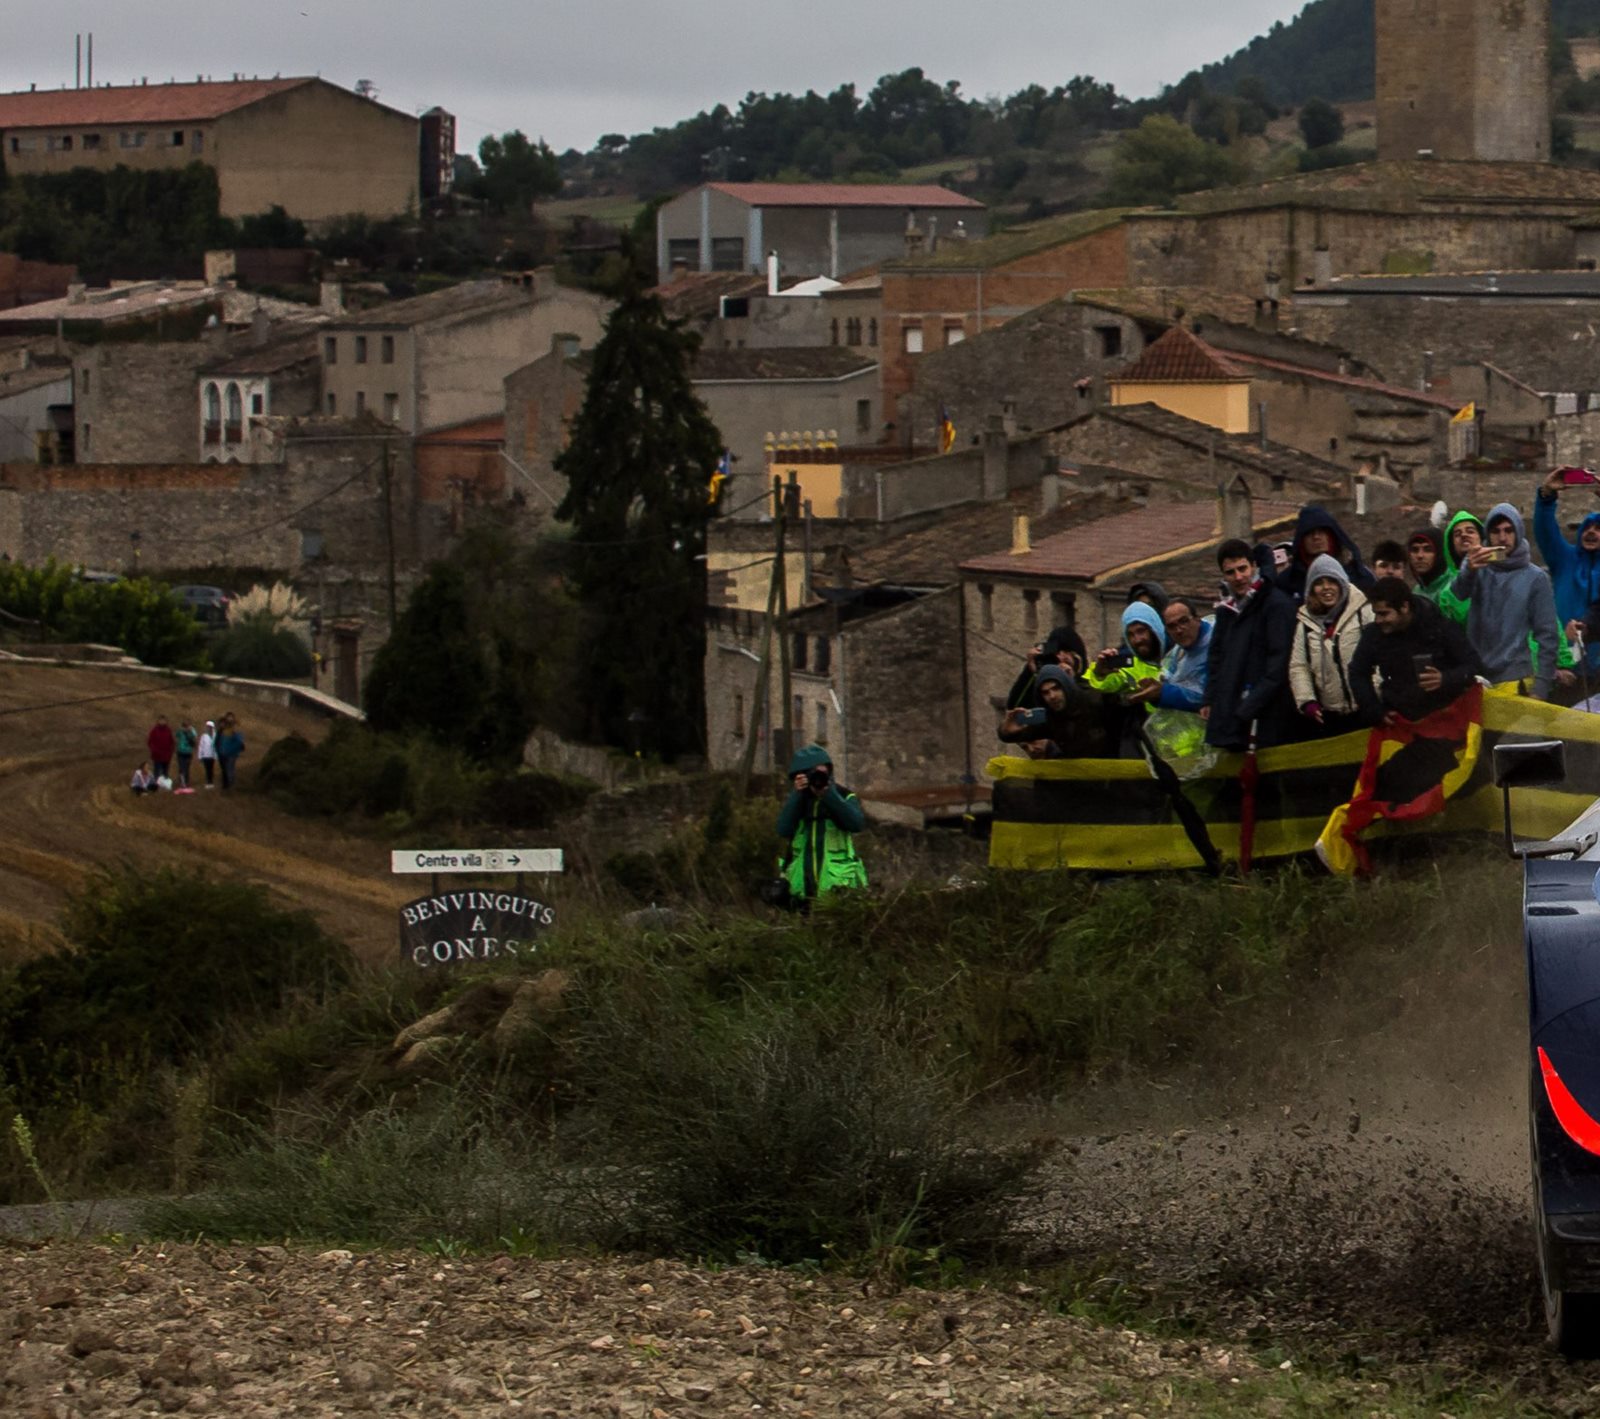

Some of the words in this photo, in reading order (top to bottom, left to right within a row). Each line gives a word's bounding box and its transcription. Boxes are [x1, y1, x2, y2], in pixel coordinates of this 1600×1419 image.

[415, 853, 458, 867] Centre
[461, 853, 482, 867] vila
[401, 891, 555, 926] BENVINGUTS
[471, 915, 486, 931] A
[413, 937, 537, 967] CONES
